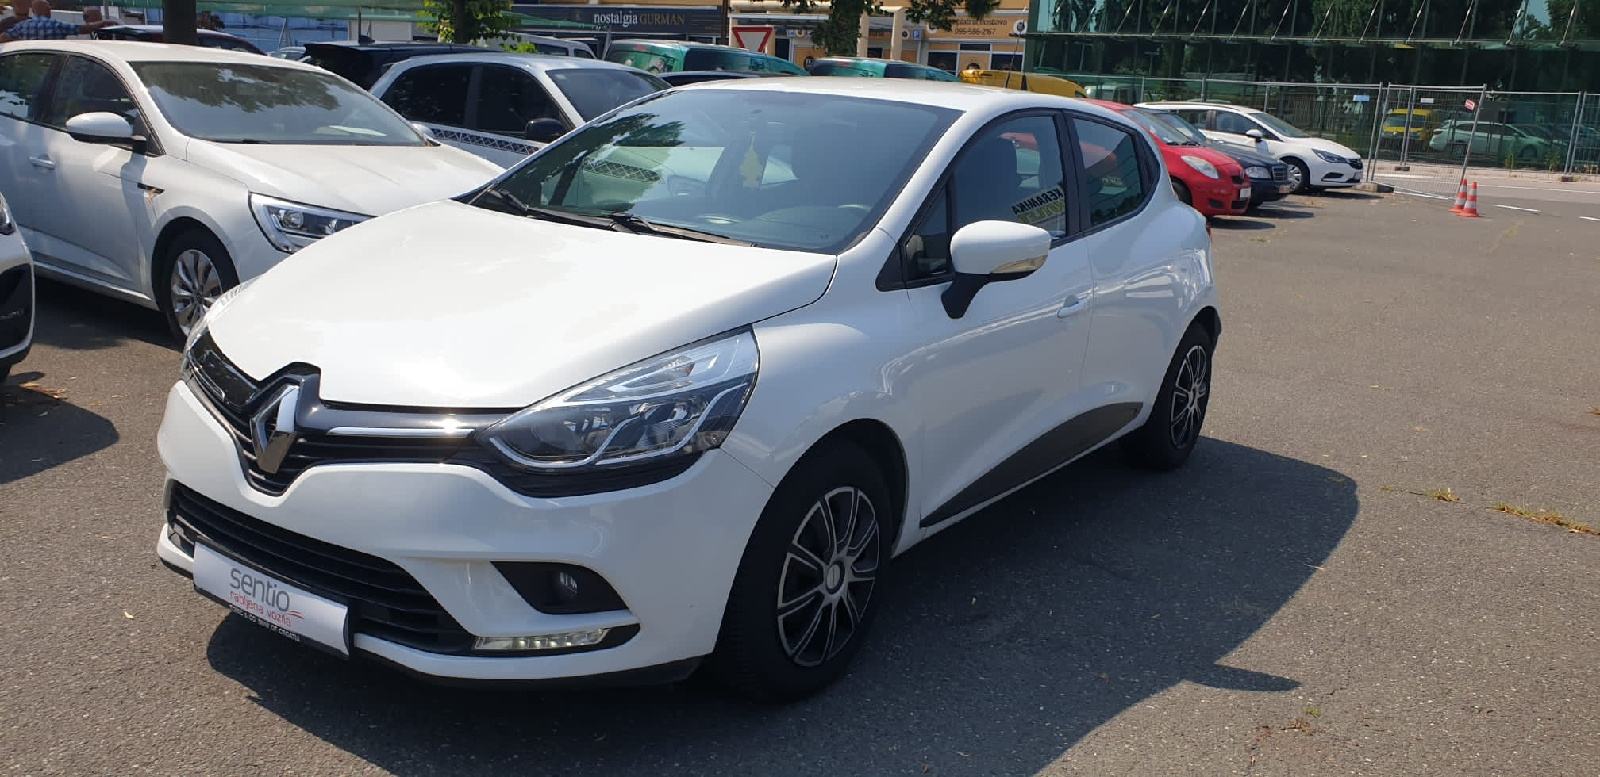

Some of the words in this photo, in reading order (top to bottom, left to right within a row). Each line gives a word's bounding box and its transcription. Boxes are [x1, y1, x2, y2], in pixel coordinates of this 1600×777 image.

[594, 10, 638, 27] nostalgia
[640, 14, 685, 25] GURMAN
[230, 568, 290, 612] sentio
[229, 591, 264, 614] rabljena
[267, 610, 292, 627] vozila
